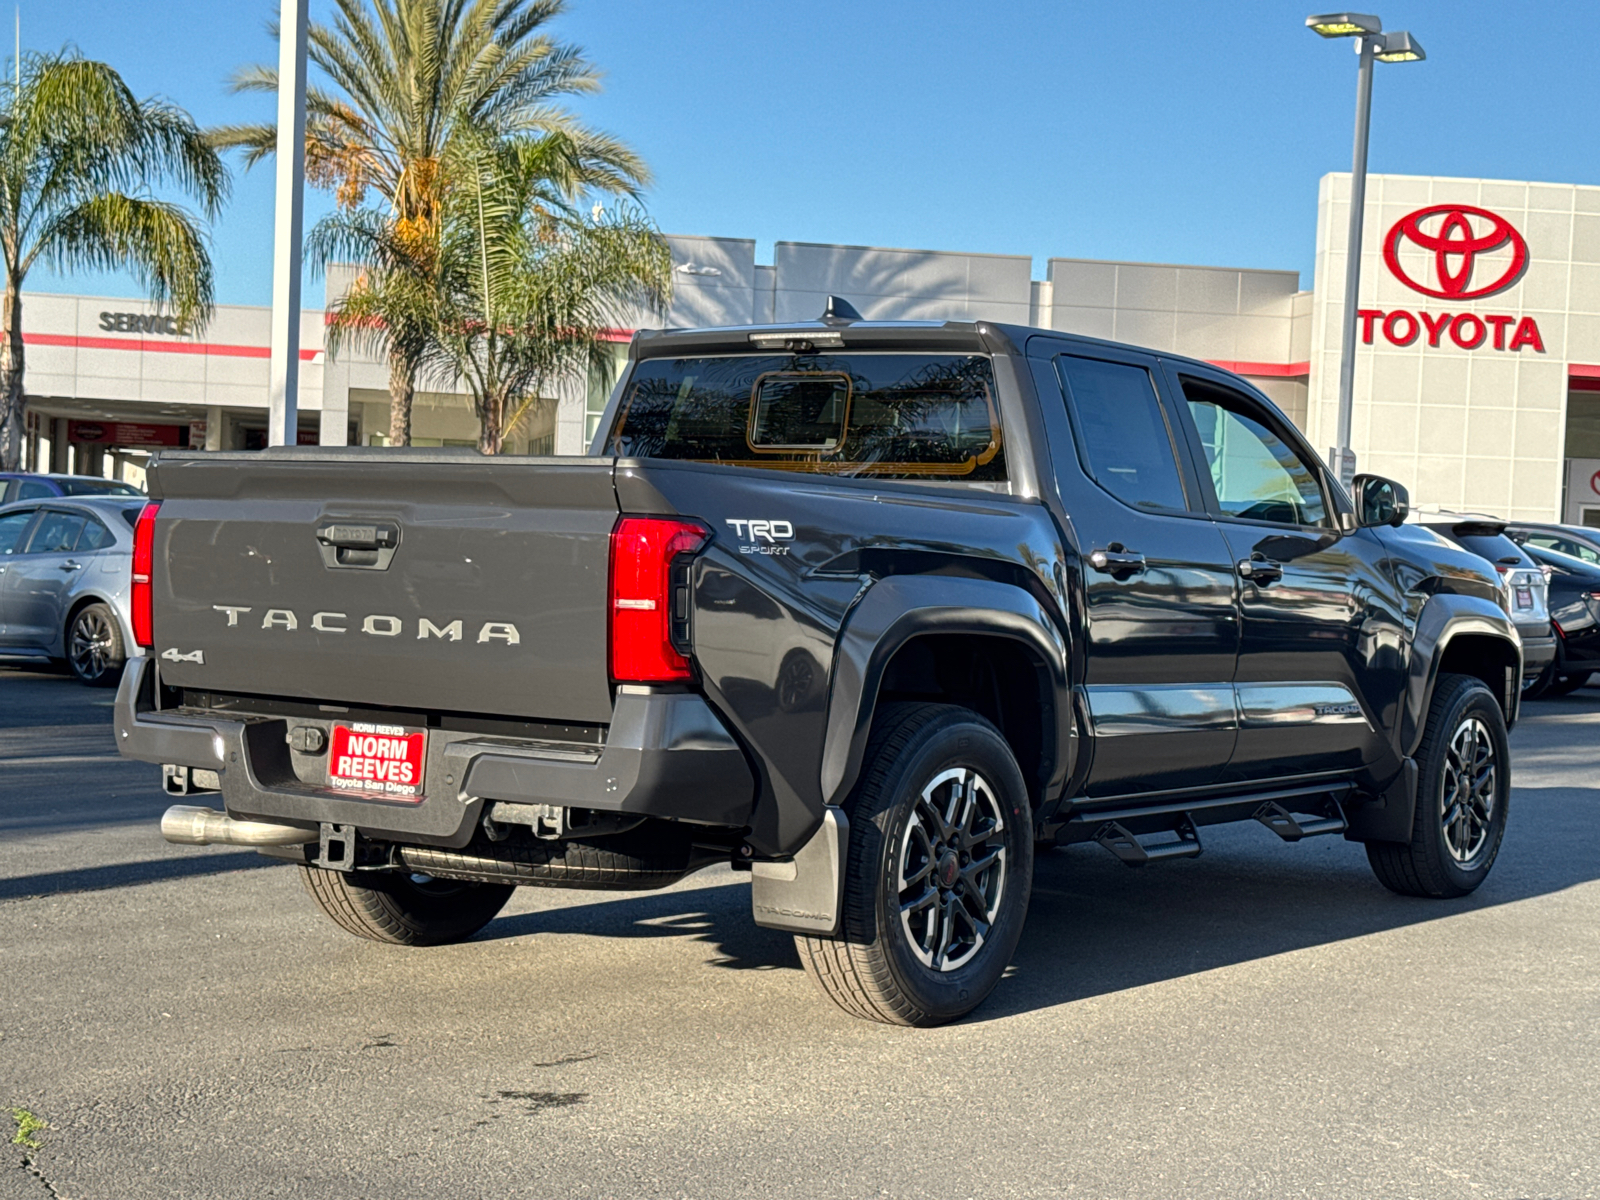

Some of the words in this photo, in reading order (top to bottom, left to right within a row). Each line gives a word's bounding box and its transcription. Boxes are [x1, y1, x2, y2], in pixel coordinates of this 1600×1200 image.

[1358, 309, 1545, 352] TOYOTA
[335, 528, 374, 540] TOYOTA
[725, 518, 794, 543] TRD
[739, 545, 790, 555] SPORT
[212, 605, 520, 644] TACOMA
[1316, 705, 1360, 714] TACOMA
[353, 723, 375, 734] NORM
[376, 725, 404, 736] REEVES
[348, 736, 408, 760] NORM
[338, 756, 413, 782] REEVES
[331, 776, 362, 788] Toyota
[364, 779, 384, 790] San
[385, 782, 415, 795] Diego
[755, 904, 832, 922] TACOMA
